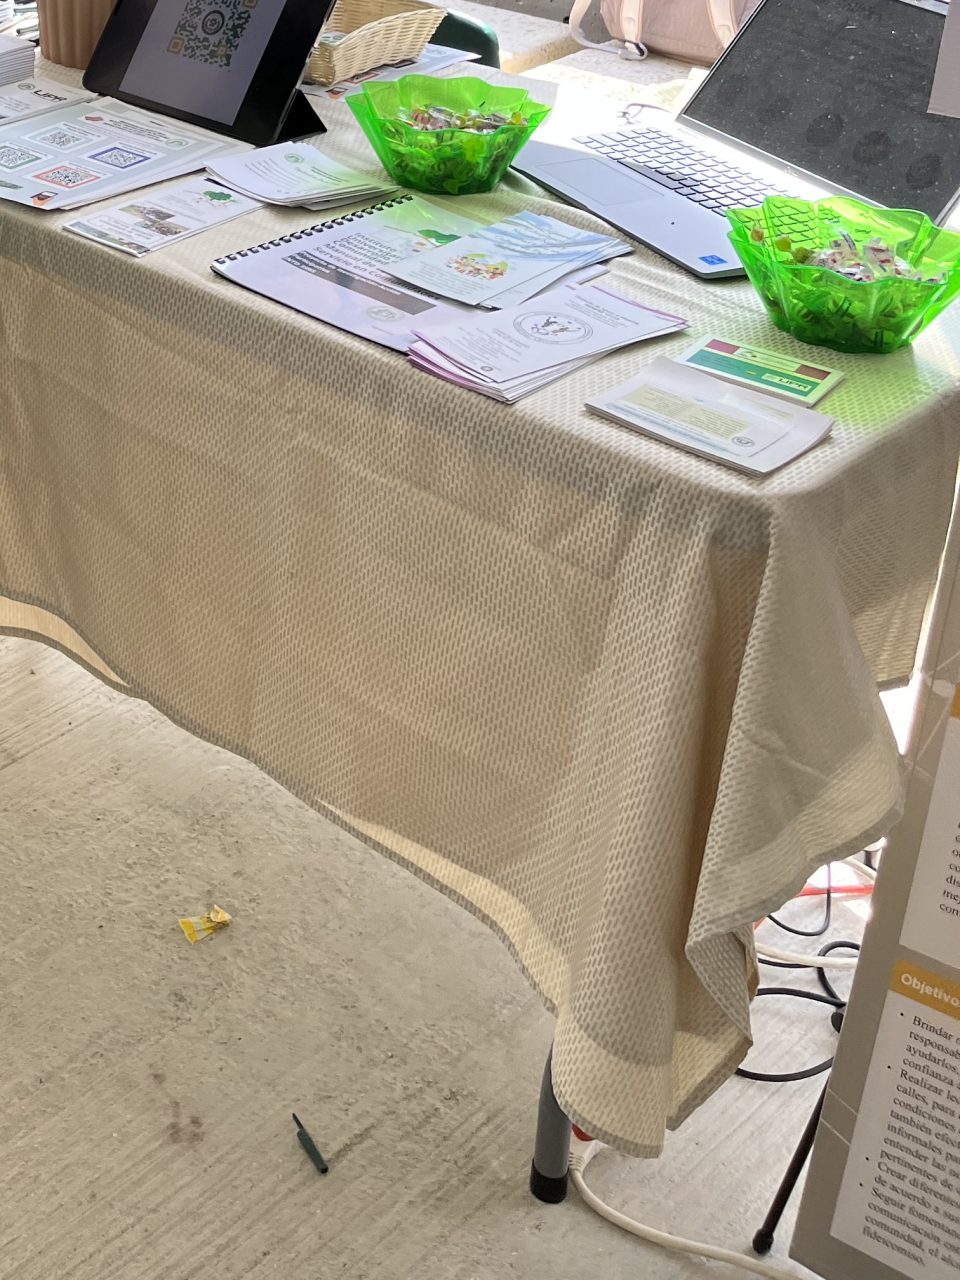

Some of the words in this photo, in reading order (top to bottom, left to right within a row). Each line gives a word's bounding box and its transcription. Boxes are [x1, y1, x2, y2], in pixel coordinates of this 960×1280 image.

[912, 1015, 954, 1041] Brindar
[900, 1068, 944, 1096] Realizar
[903, 1058, 954, 1086] confianza
[890, 1109, 932, 1135] también
[893, 1097, 956, 1133] condiciones
[883, 1137, 929, 1163] entender
[887, 1123, 942, 1155] informales
[878, 1161, 907, 1181] Crear
[880, 1150, 938, 1182] pertinentes
[872, 1186, 906, 1211] Seguir
[874, 1175, 887, 1187] de
[889, 1183, 931, 1209] acuerdo
